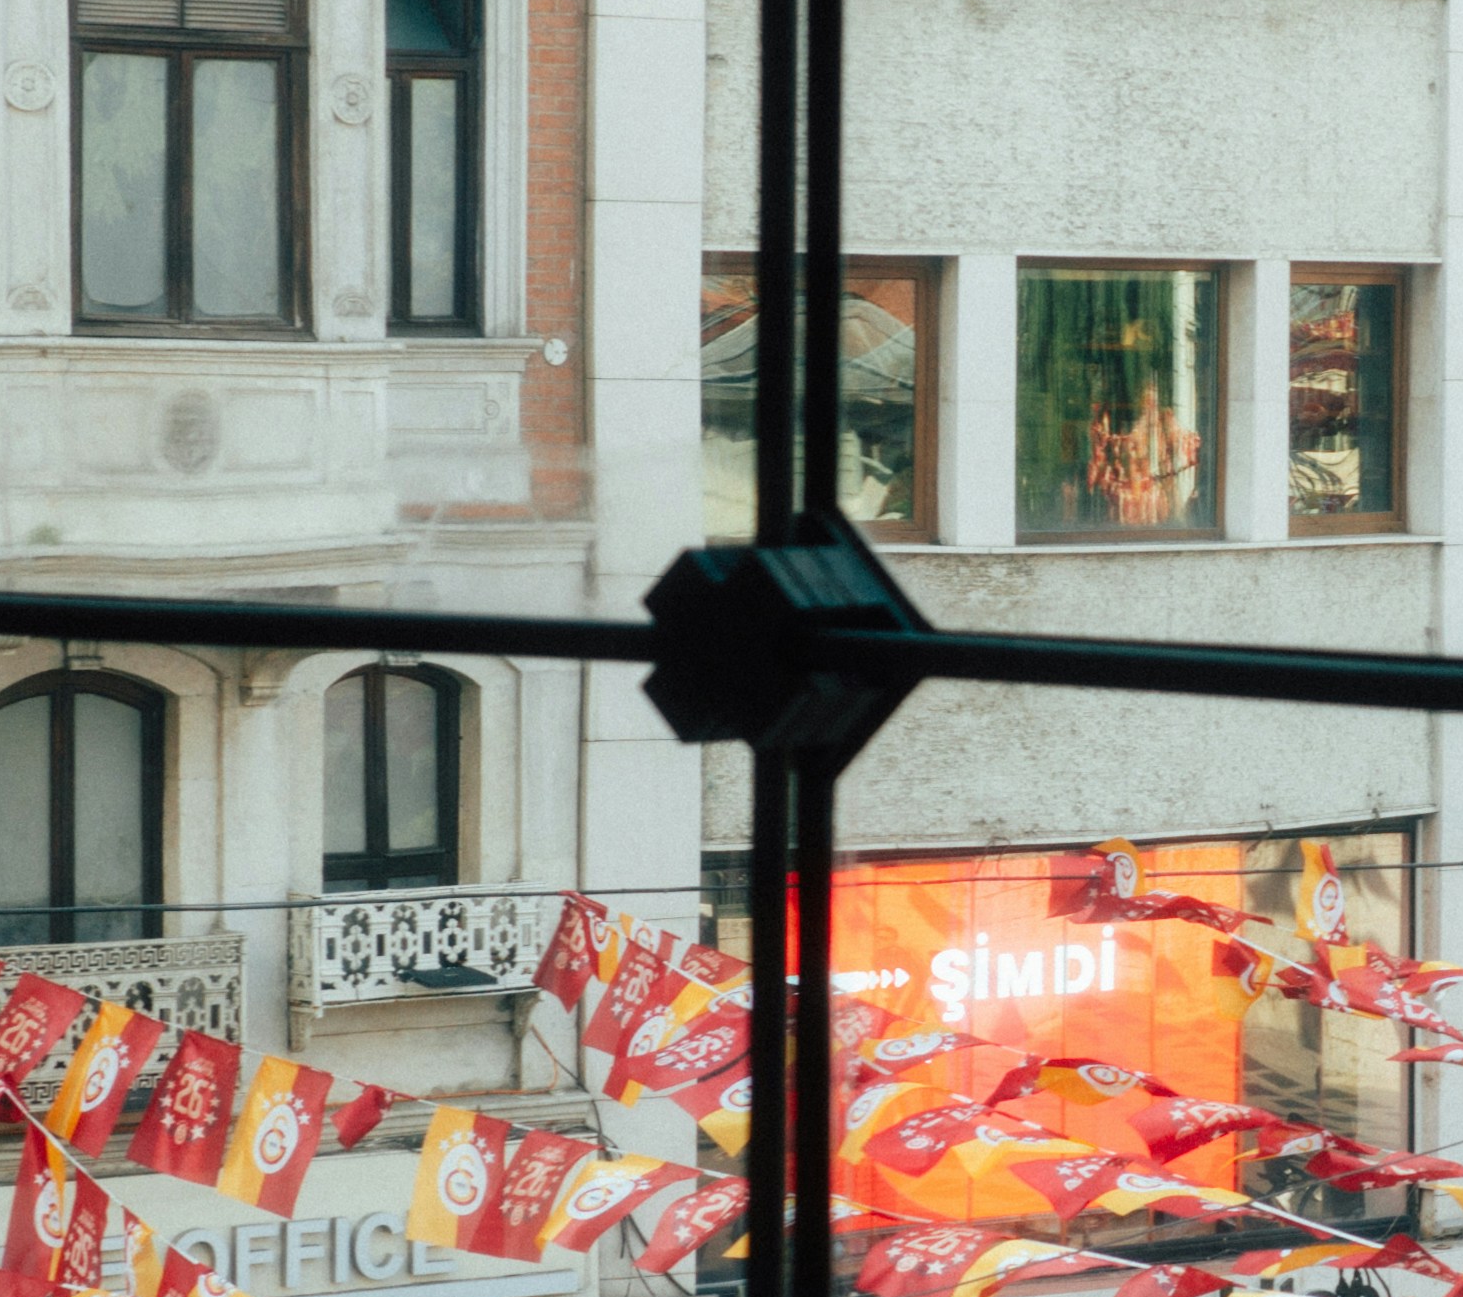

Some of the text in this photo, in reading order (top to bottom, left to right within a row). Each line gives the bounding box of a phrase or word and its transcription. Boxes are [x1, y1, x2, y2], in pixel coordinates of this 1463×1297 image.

[930, 925, 1116, 1023] ŞİMDİ
[175, 1074, 208, 1119] 26
[173, 1211, 460, 1291] OFFICE
